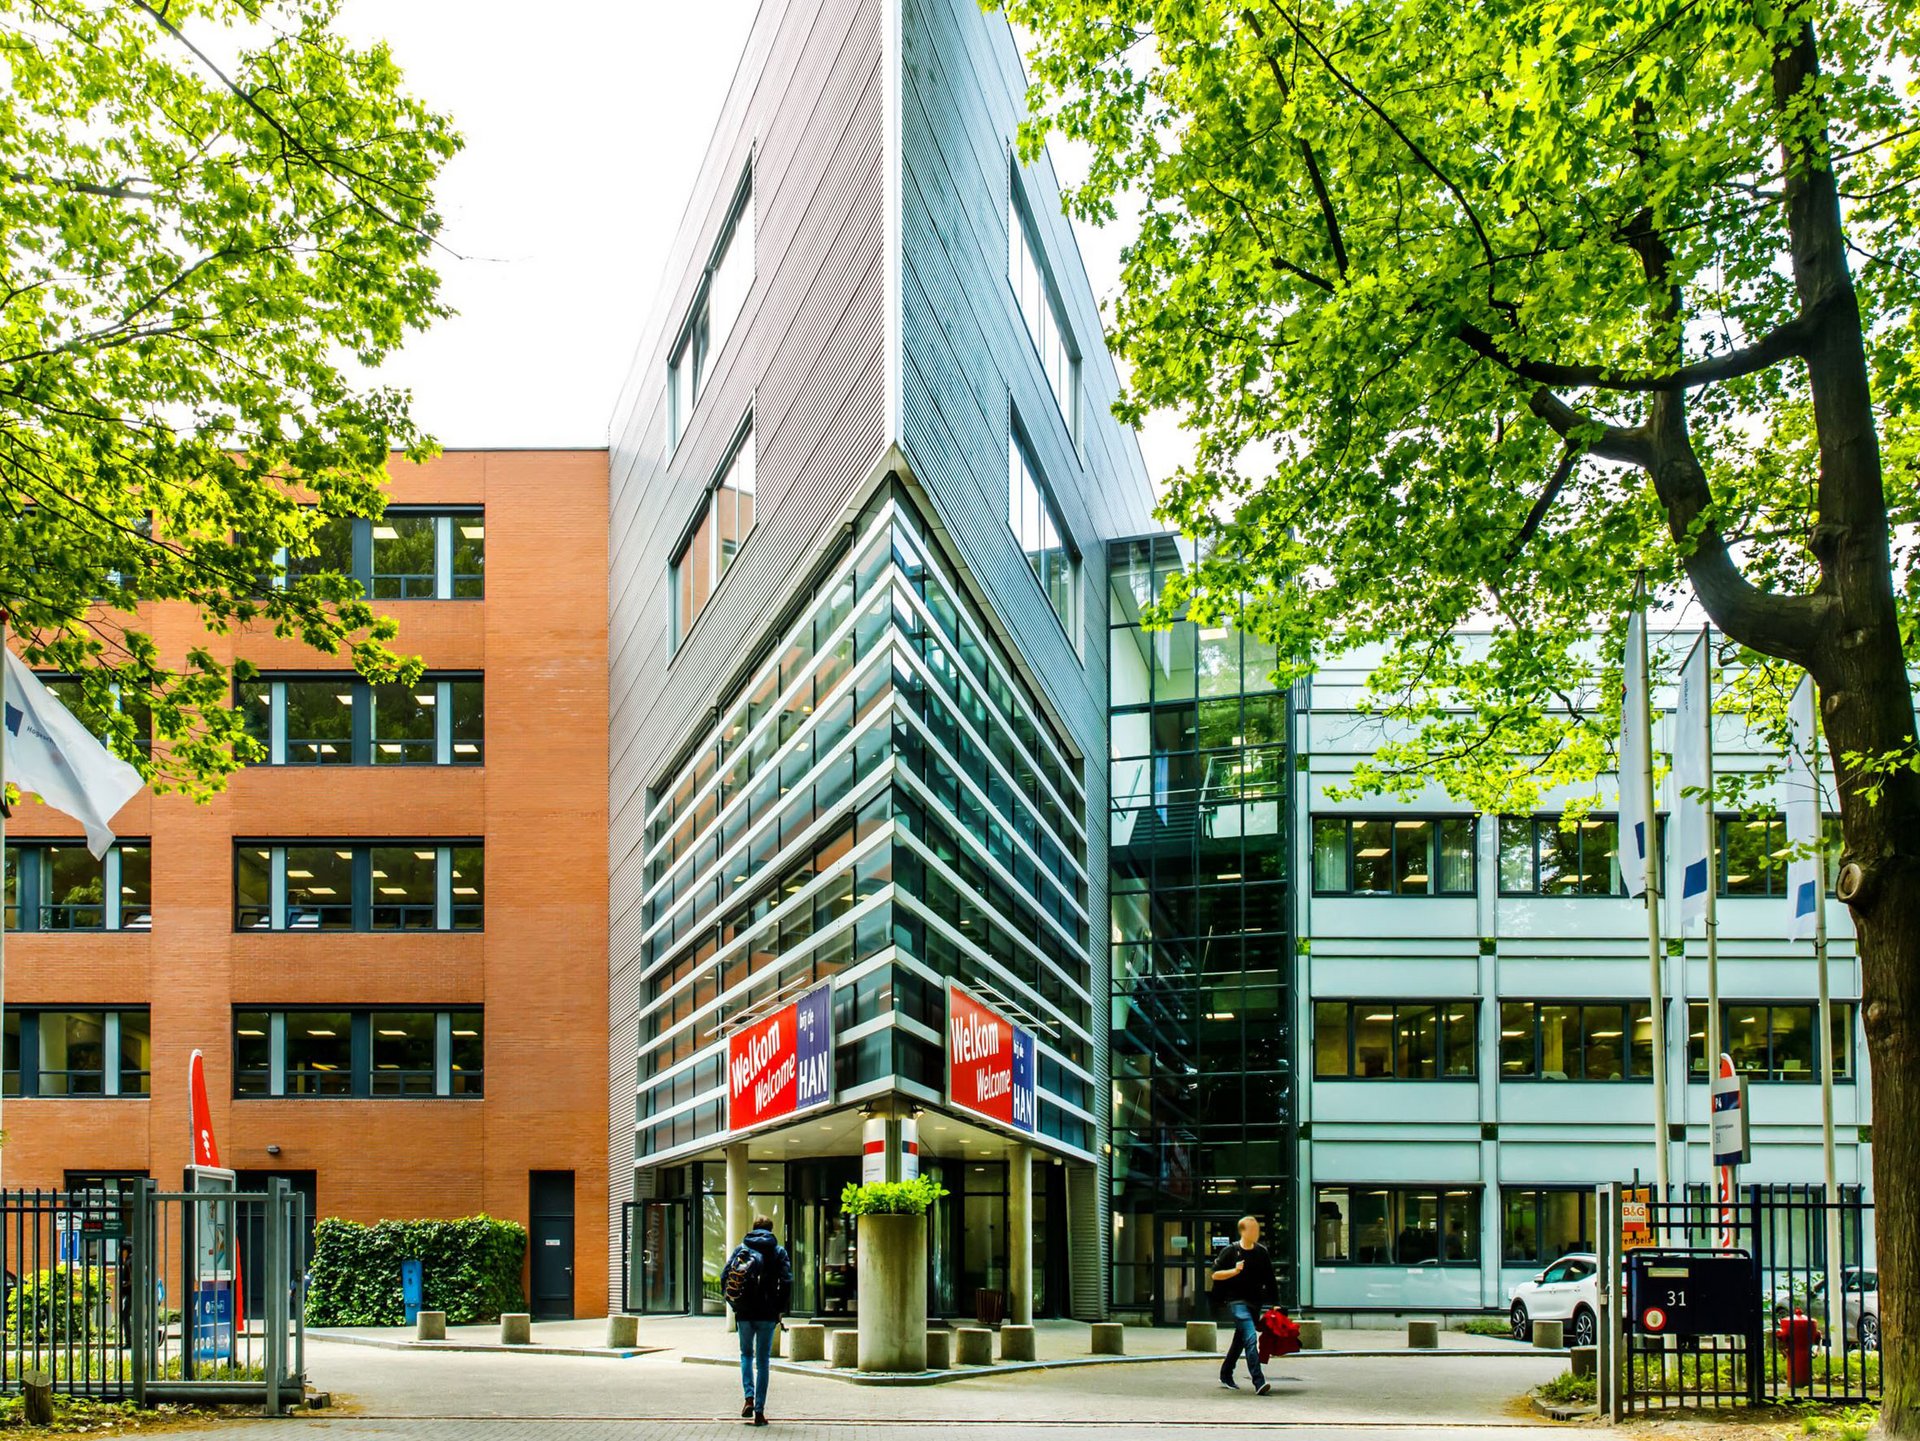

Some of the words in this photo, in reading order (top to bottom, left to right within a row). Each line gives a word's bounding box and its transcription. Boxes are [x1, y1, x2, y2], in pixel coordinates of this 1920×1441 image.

[799, 1010, 807, 1031] bij
[950, 1013, 1000, 1065] Welkom
[731, 1020, 780, 1099] Welkom
[799, 1050, 828, 1100] HAN
[754, 1053, 796, 1115] Welcome
[976, 1064, 1011, 1103] Welcome
[1013, 1083, 1032, 1125] HAN
[1623, 1205, 1645, 1217] B&G
[1666, 1290, 1686, 1307] 31
